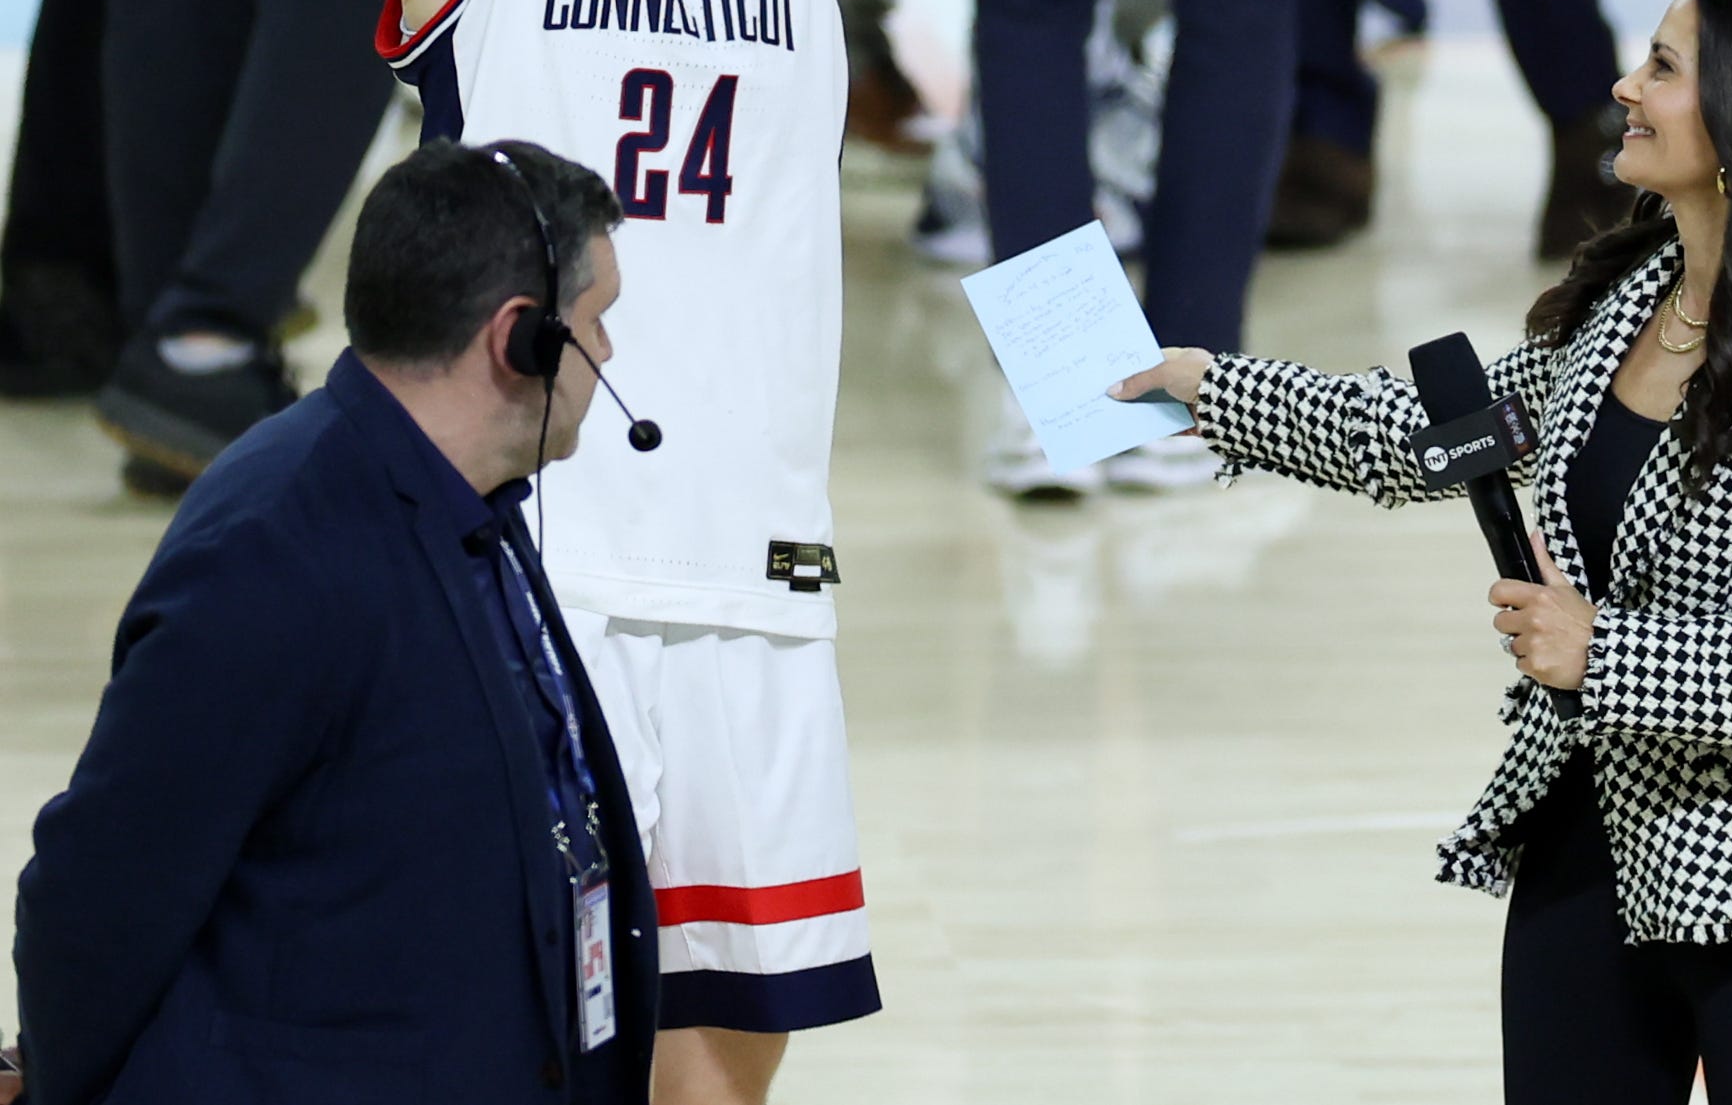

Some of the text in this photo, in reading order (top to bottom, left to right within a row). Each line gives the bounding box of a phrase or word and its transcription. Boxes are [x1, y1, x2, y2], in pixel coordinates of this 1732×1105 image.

[614, 67, 739, 224] 24
[1424, 435, 1496, 467] TNT SPORTS
